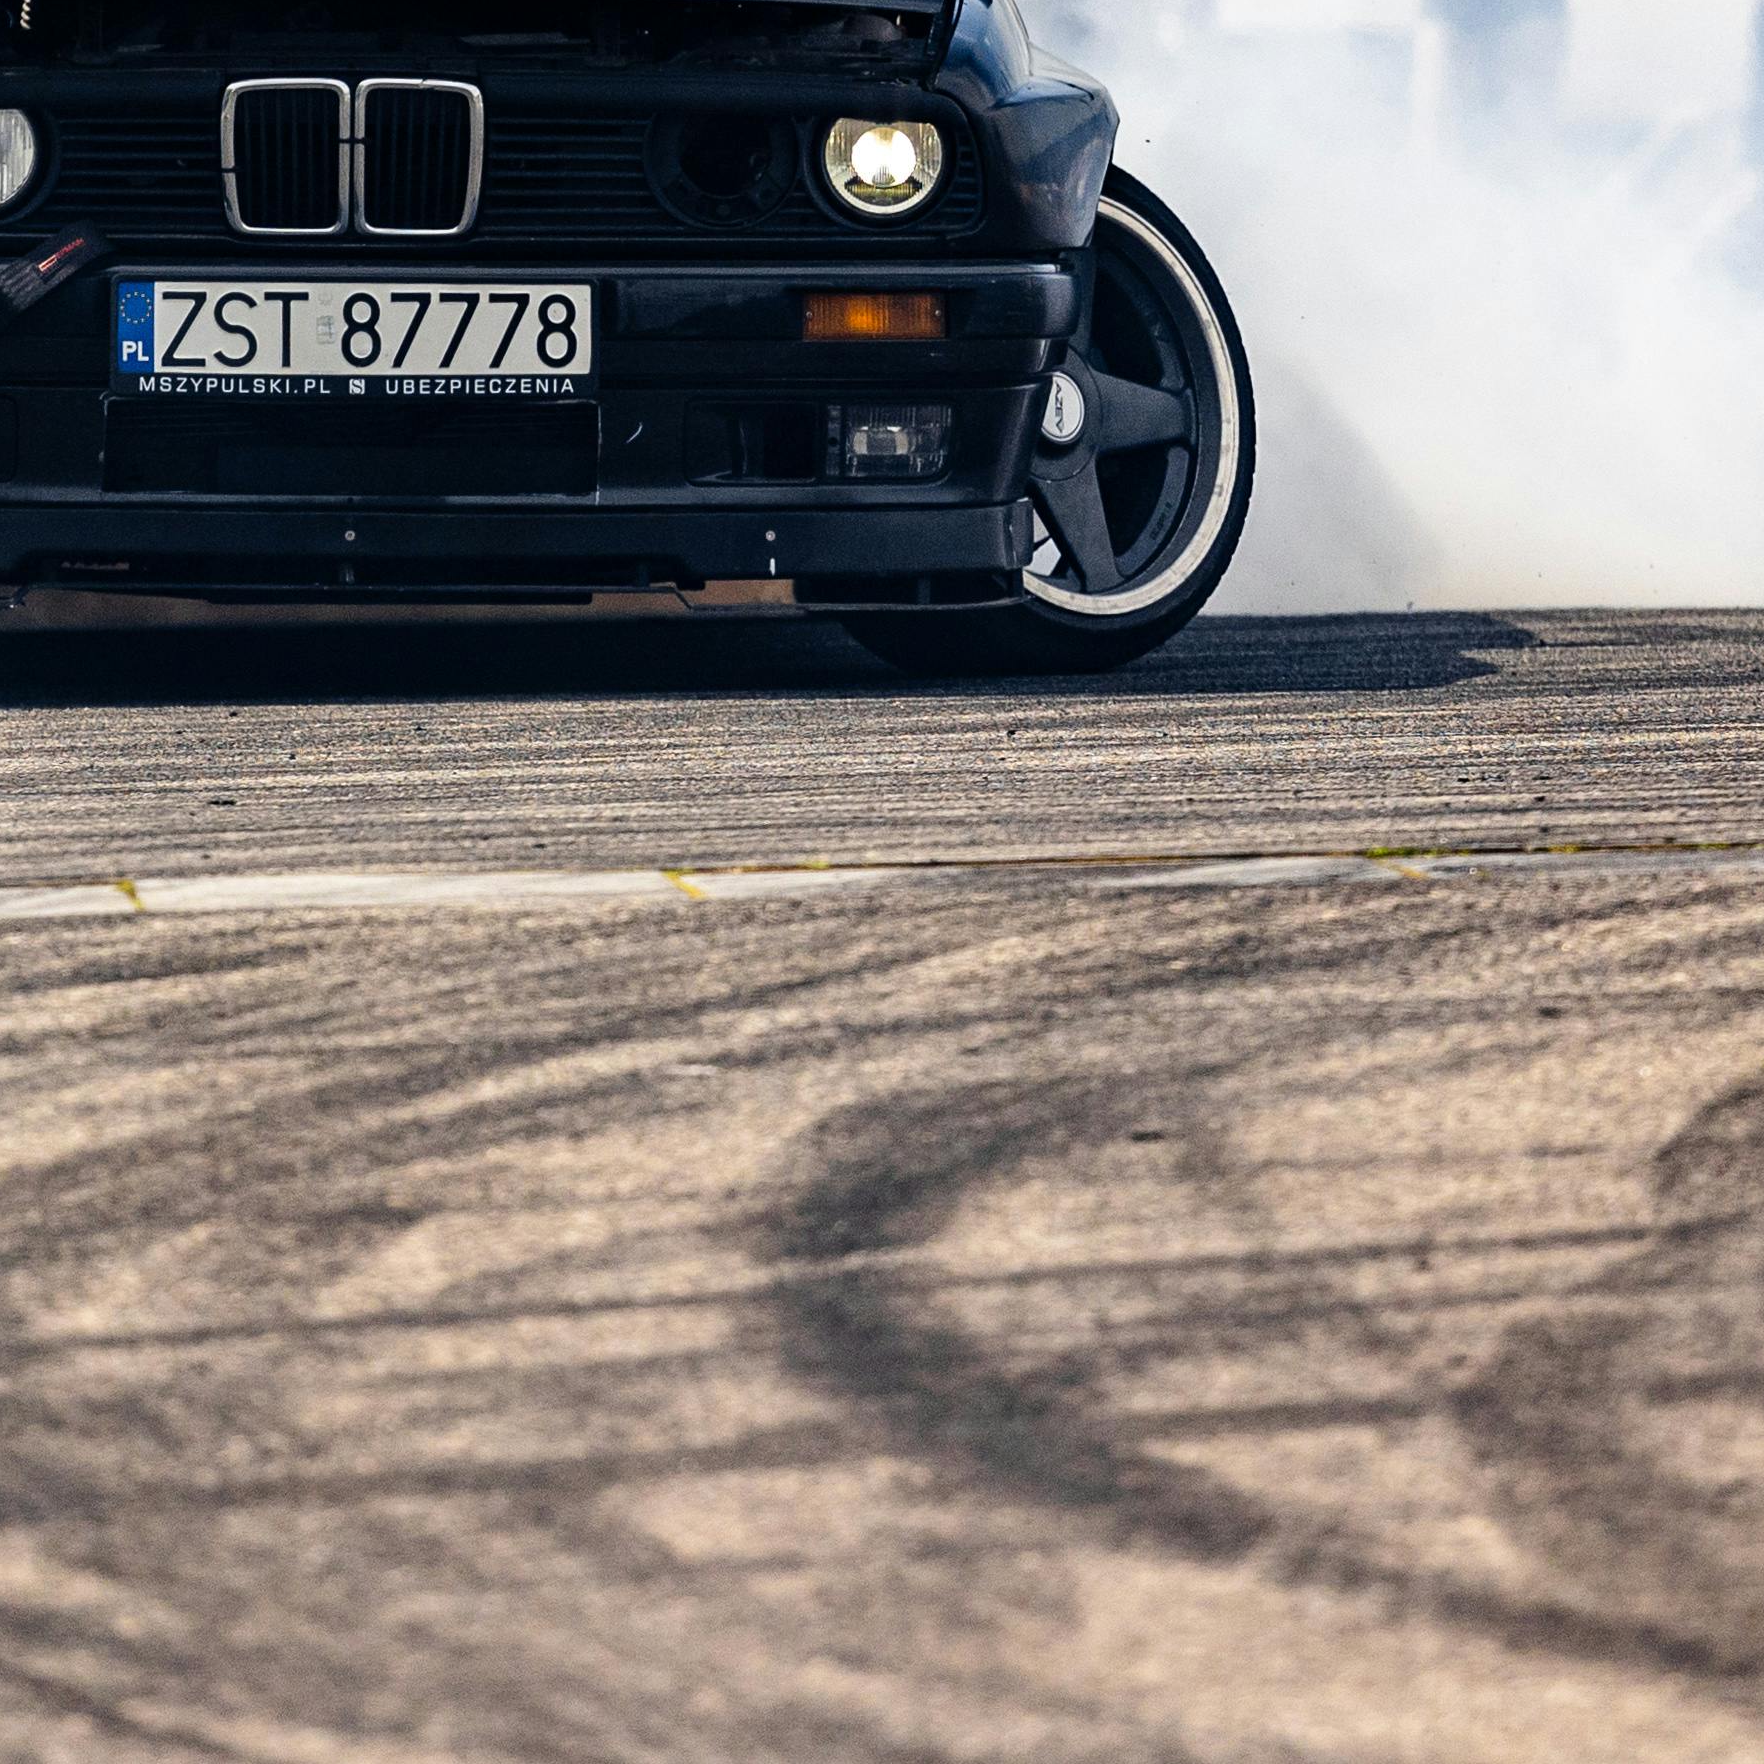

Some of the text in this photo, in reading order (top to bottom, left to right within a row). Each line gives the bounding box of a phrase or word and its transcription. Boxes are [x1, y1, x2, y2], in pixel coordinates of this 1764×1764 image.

[161, 291, 578, 368] ZST 87778
[122, 340, 150, 362] PL
[139, 377, 331, 394] MSZYPULSKI.PL
[386, 378, 575, 395] UBEZPIECZENIA
[1054, 380, 1064, 433] AZEV
